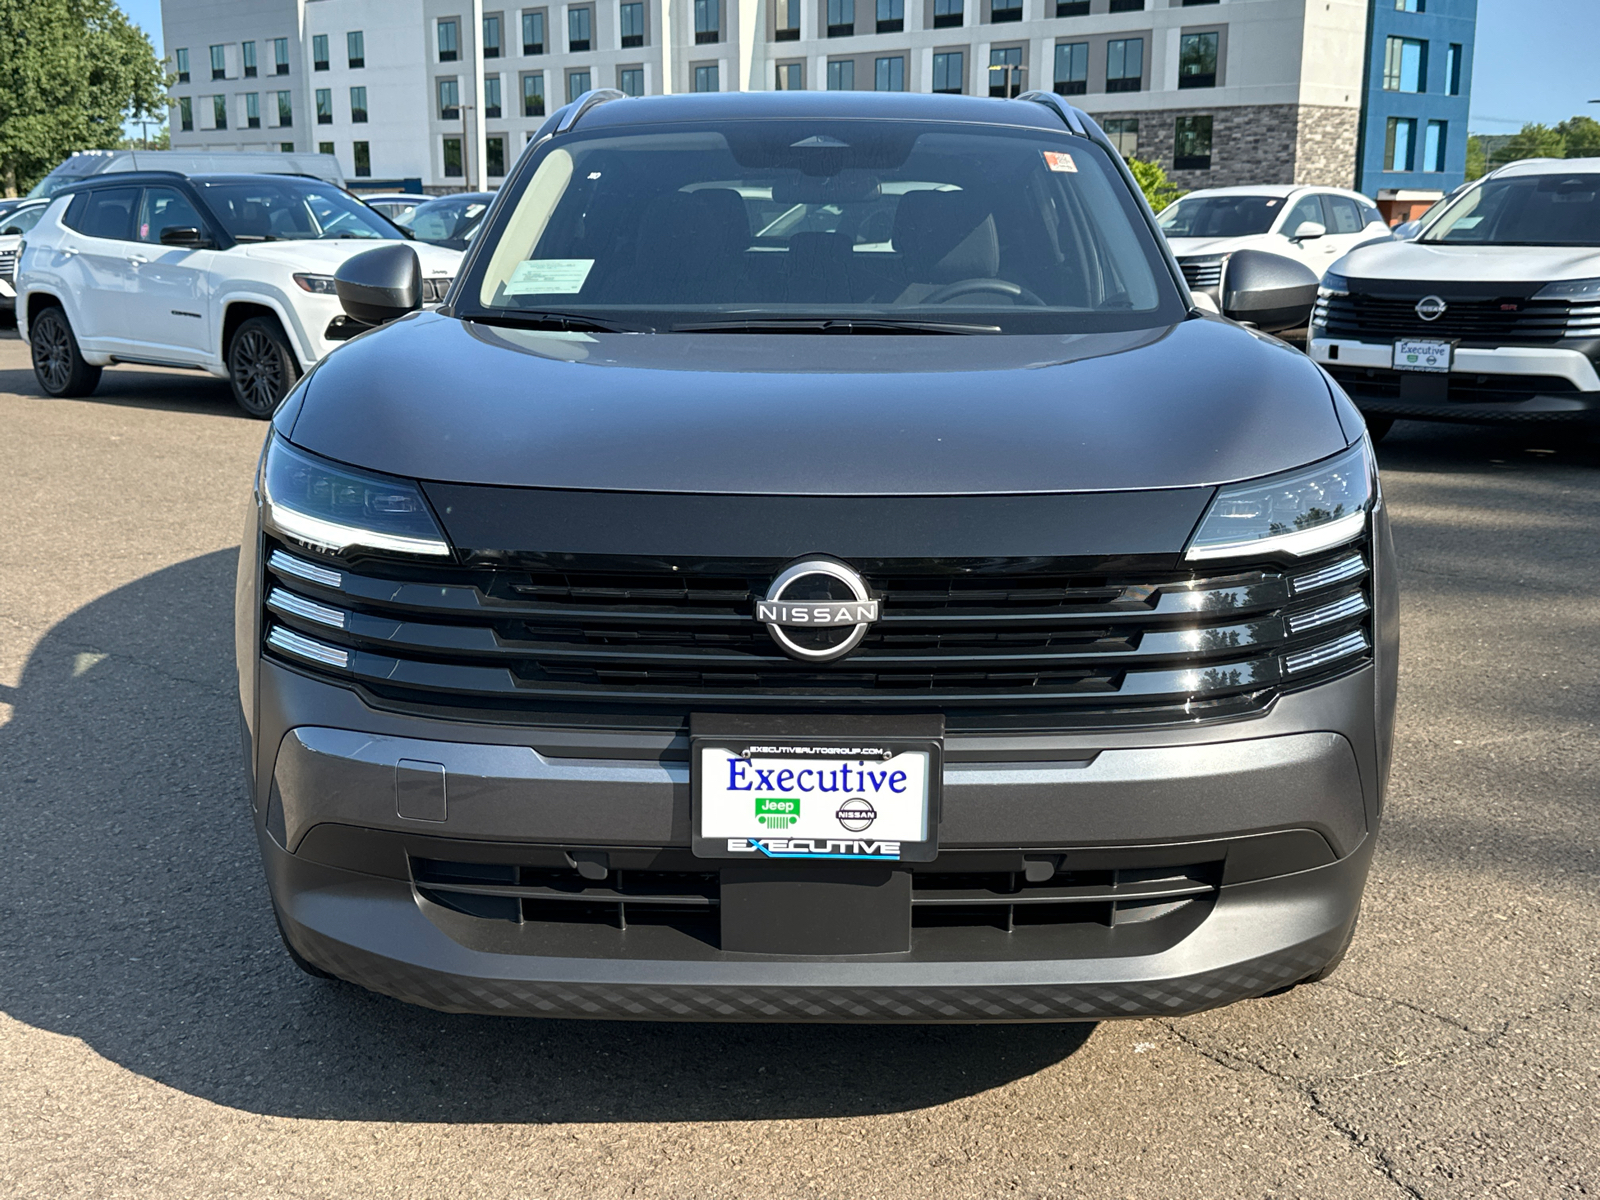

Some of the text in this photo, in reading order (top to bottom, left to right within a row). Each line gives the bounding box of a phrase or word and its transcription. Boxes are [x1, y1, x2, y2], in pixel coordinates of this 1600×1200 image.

[1400, 344, 1445, 356] Executive
[759, 605, 876, 622] NISSAN
[749, 746, 883, 755] EXECUTIVEAUTOGROUP.COM
[726, 758, 908, 793] Executive
[761, 800, 795, 813] Jeep
[838, 811, 875, 819] NISSAN
[727, 838, 901, 855] EXECUTIVE
